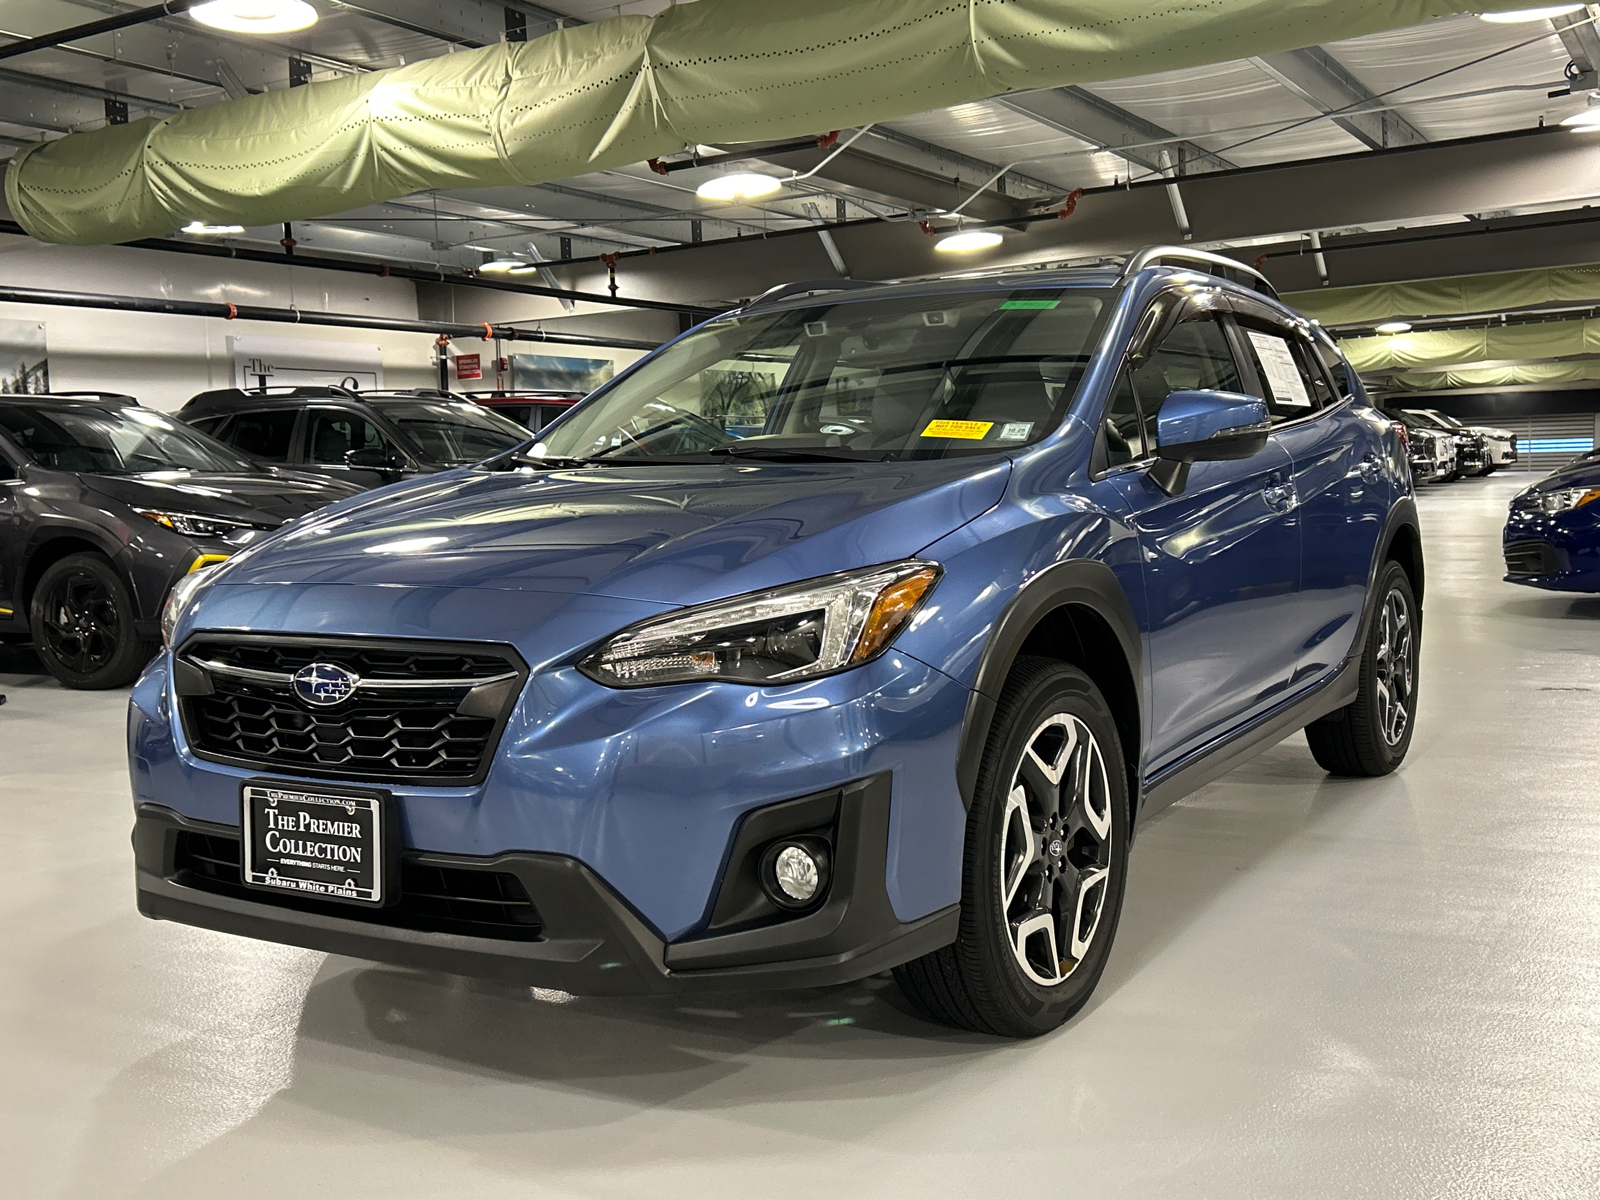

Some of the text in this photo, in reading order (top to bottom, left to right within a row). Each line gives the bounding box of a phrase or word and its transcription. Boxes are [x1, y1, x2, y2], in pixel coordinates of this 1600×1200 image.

[249, 358, 274, 373] The
[264, 808, 362, 839] THE PREMIER
[265, 831, 362, 863] COLLECTION
[280, 857, 312, 868] EVERYTHING
[312, 862, 330, 870] STARTS
[265, 876, 358, 898] Subaru White Plains
[992, 854, 1001, 922] CONTROL
